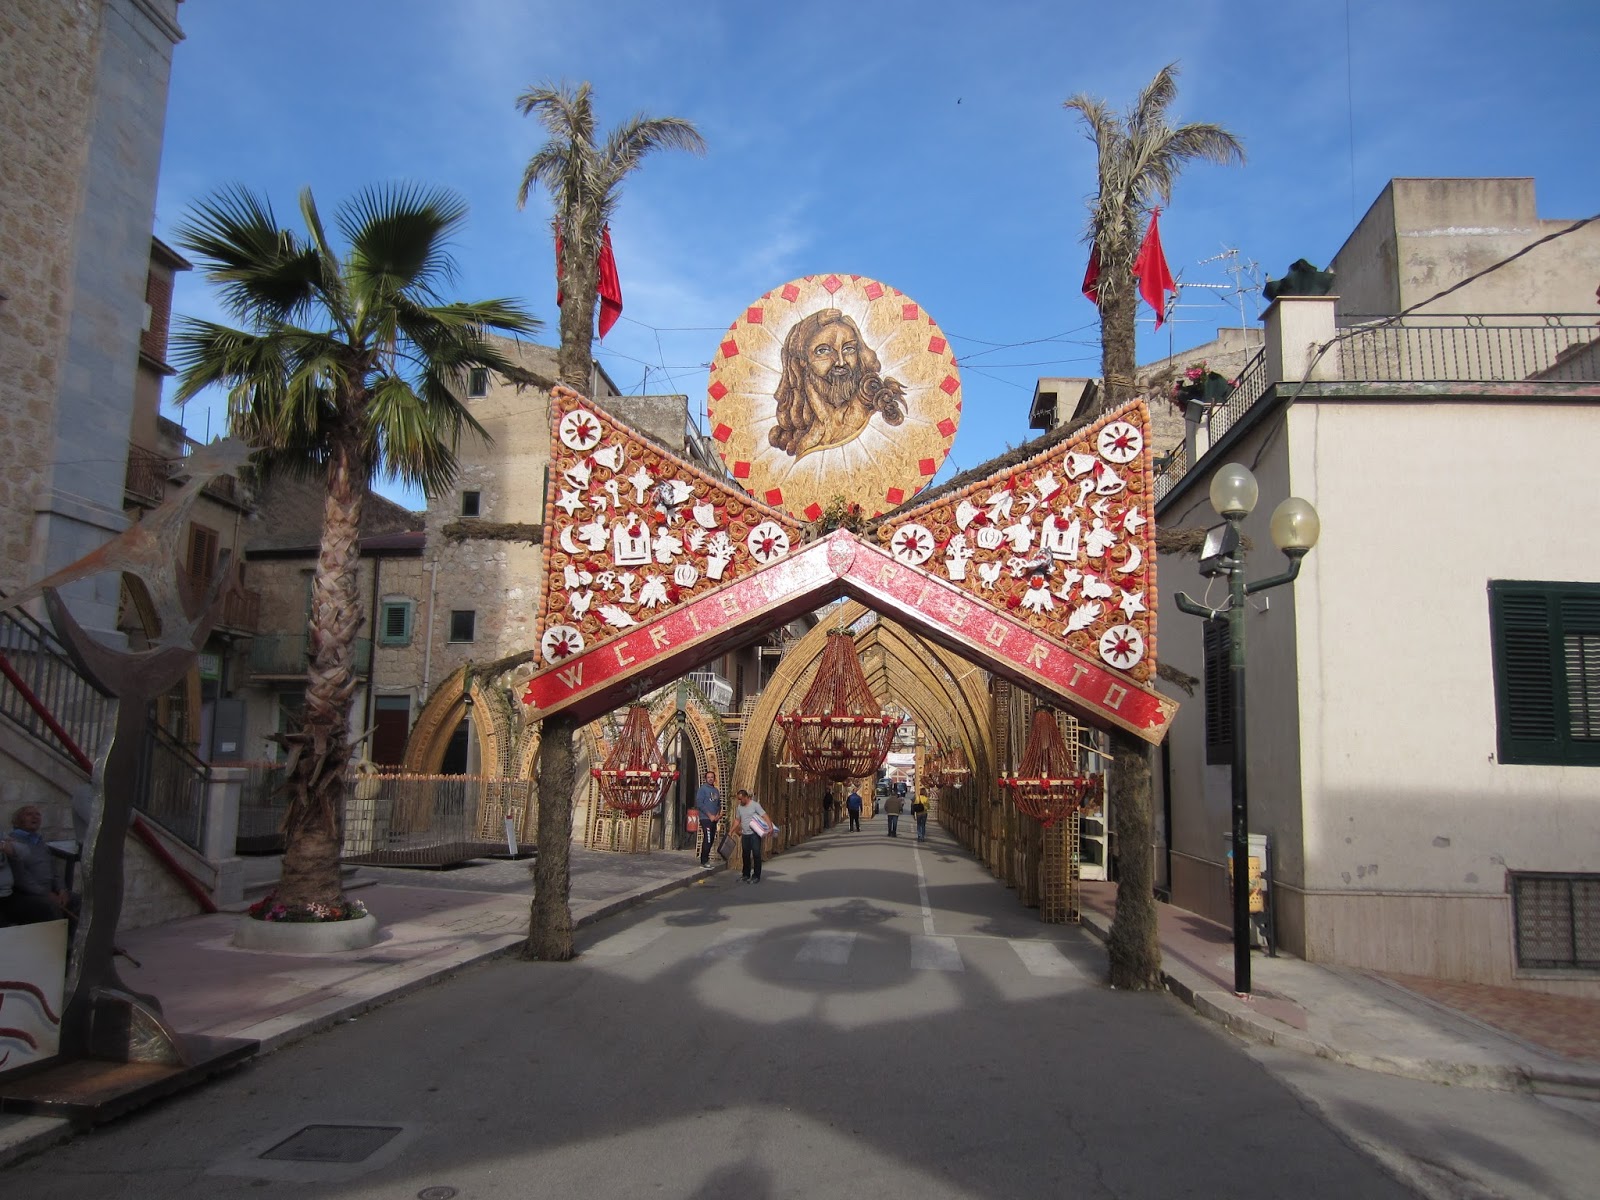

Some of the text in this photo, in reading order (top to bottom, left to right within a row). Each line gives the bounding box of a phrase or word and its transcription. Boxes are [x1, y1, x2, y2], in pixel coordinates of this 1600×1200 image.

[555, 558, 808, 690] W CRIST
[874, 562, 1128, 711] RISORTO
